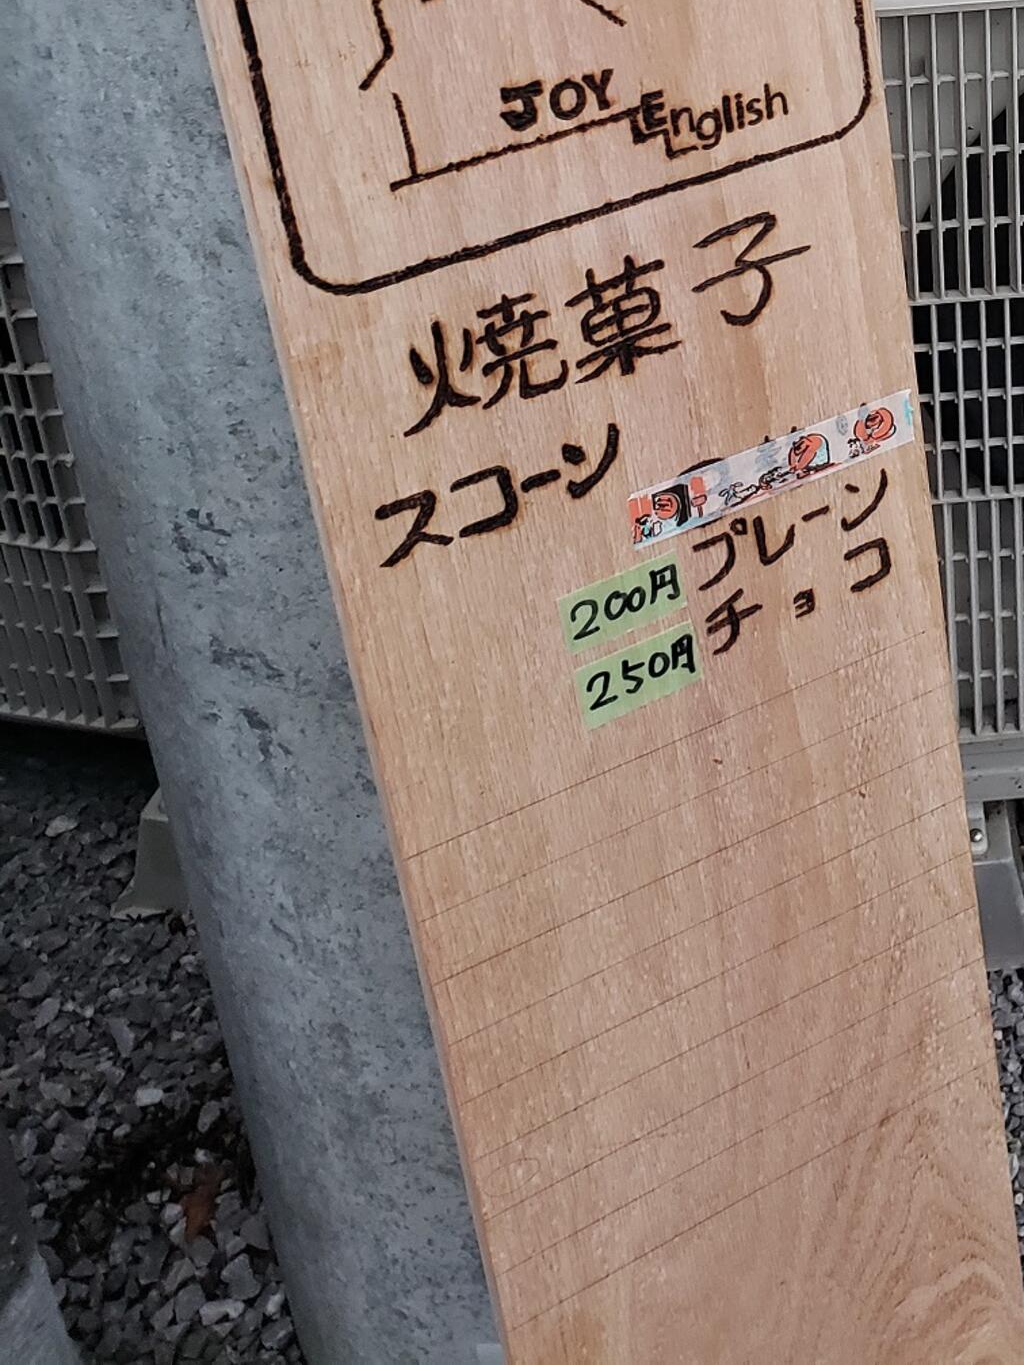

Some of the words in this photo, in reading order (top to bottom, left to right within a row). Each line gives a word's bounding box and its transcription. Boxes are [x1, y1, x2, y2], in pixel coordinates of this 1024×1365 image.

[500, 68, 614, 131] JOY
[641, 83, 789, 150] English
[404, 211, 811, 437] 焼菓子
[375, 423, 620, 568] スコーン
[692, 468, 888, 591] プレーン
[570, 563, 681, 641] 200円
[704, 536, 892, 656] チョコ
[586, 633, 696, 711] 250円
